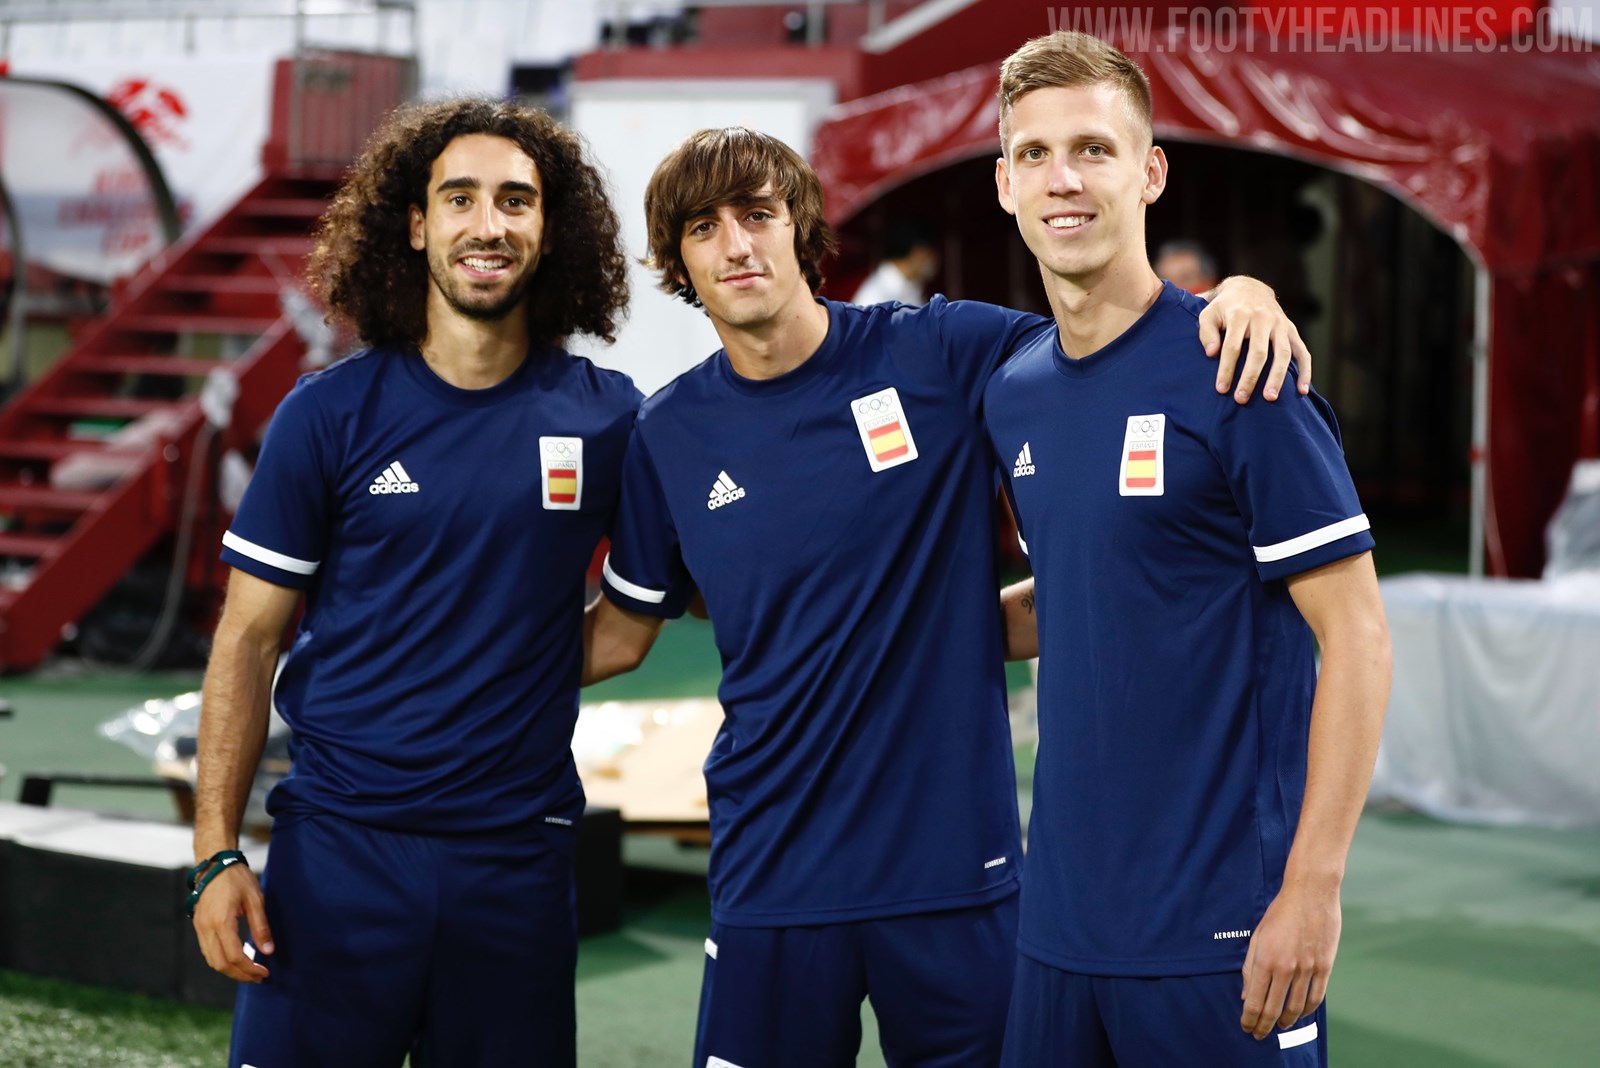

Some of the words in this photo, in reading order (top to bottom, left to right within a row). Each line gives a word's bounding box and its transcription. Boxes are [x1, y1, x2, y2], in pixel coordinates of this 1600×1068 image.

[369, 481, 419, 494] adidas
[707, 487, 745, 510] adidas
[1213, 930, 1251, 940] AEROREADY
